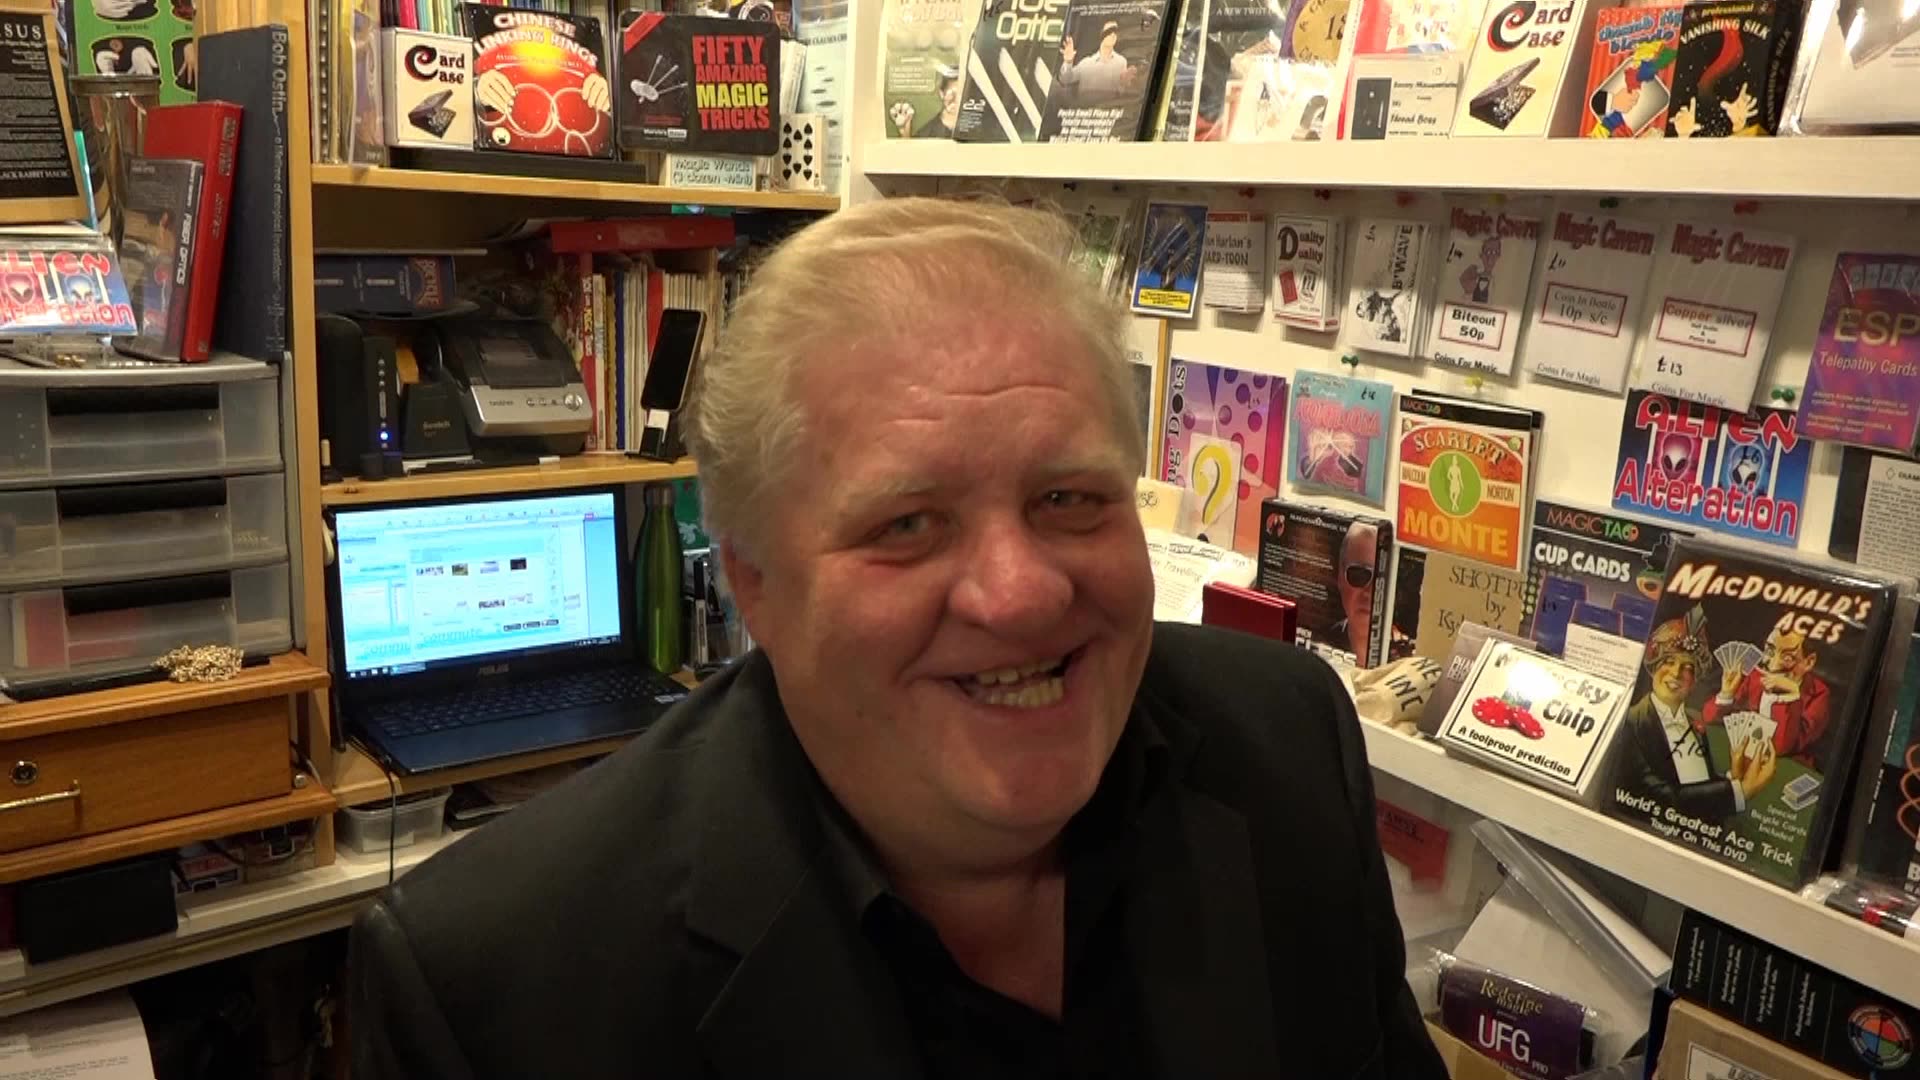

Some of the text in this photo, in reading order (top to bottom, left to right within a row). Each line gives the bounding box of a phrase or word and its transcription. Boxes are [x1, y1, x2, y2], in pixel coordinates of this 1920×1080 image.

[0, 23, 42, 40] SUS
[493, 12, 577, 38] CHINESE
[1680, 18, 1772, 44] VANISHING SILK
[270, 31, 287, 64] Bob
[474, 29, 545, 55] LINKING
[551, 33, 598, 67] RINGS
[692, 35, 765, 65] FIFTY
[695, 64, 767, 83] AMAZING
[270, 68, 286, 113] Ostin
[695, 83, 768, 109] MAGIC
[699, 107, 770, 131] TRICKS
[1553, 211, 1655, 256] Magic Cavern
[1671, 223, 1791, 271] Magic Cavern
[1451, 307, 1498, 328] Biteout
[1559, 303, 1582, 323] 10p
[1665, 303, 1712, 322] Copper
[1833, 308, 1920, 347] ESP
[1459, 325, 1486, 342] 50p
[1434, 352, 1498, 374] Coins For Magic
[1560, 368, 1575, 380] For
[1576, 371, 1600, 385] Magic
[1820, 351, 1919, 377] Telepathy Cards
[1651, 382, 1677, 395] Coins
[1679, 388, 1695, 399] For
[1636, 394, 1800, 453] ALIEN
[1413, 430, 1509, 466] SCARLET
[1486, 484, 1515, 501] NORTON
[1614, 457, 1799, 540] Alteration
[1403, 506, 1509, 558] MONTE
[1534, 541, 1631, 583] CUP CARDS
[1485, 592, 1507, 622] by
[1542, 698, 1596, 738] Chip
[1458, 724, 1572, 777] A foolproof prediction
[1615, 787, 1795, 868] World's Greatest Ace Trick
[1650, 816, 1749, 864] Taught On This DVD
[1480, 978, 1543, 1015] Redefine
[1478, 1014, 1531, 1064] UFG
